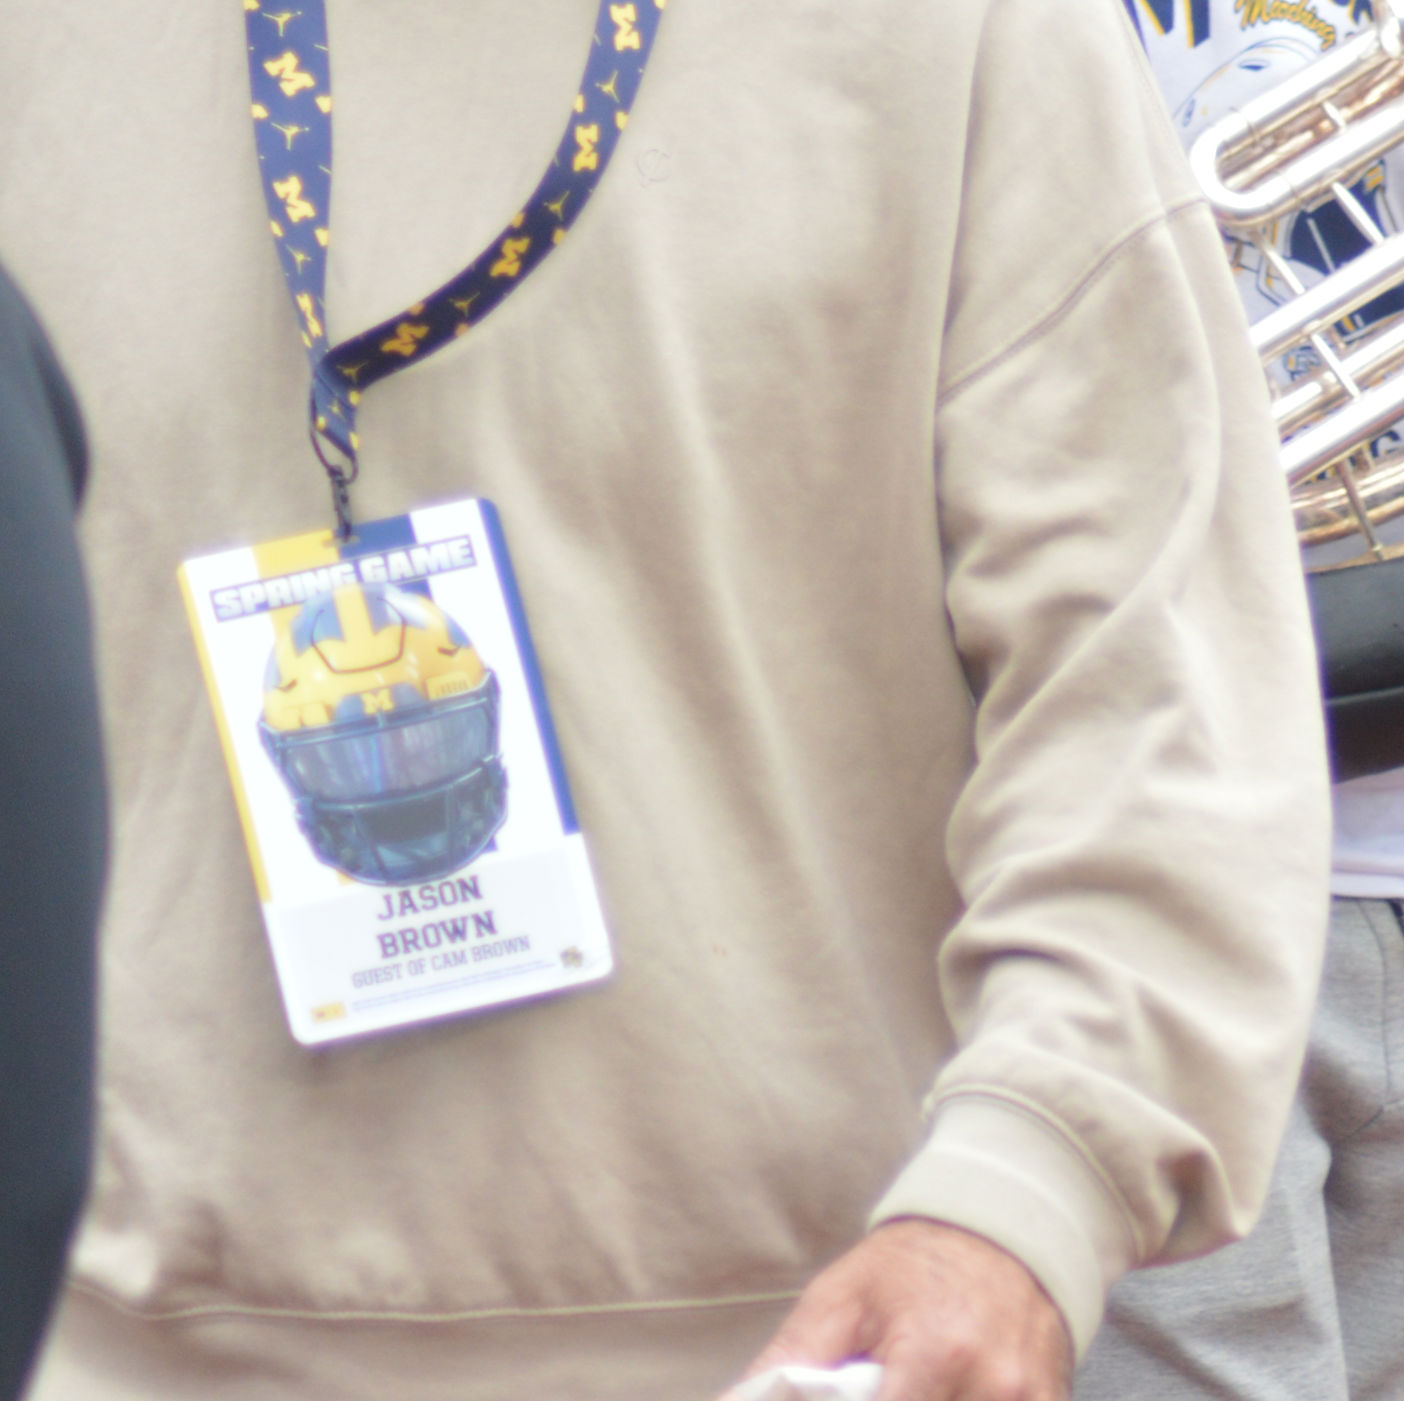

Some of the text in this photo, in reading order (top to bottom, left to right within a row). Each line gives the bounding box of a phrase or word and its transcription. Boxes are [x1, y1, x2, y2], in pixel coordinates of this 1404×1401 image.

[210, 535, 477, 623] SPRING GAME
[377, 874, 483, 922] JASON
[376, 909, 498, 960] BROWN
[352, 963, 403, 989] GUEST
[407, 958, 427, 978] OF
[430, 947, 468, 972] CAM
[472, 935, 531, 963] BROWN
